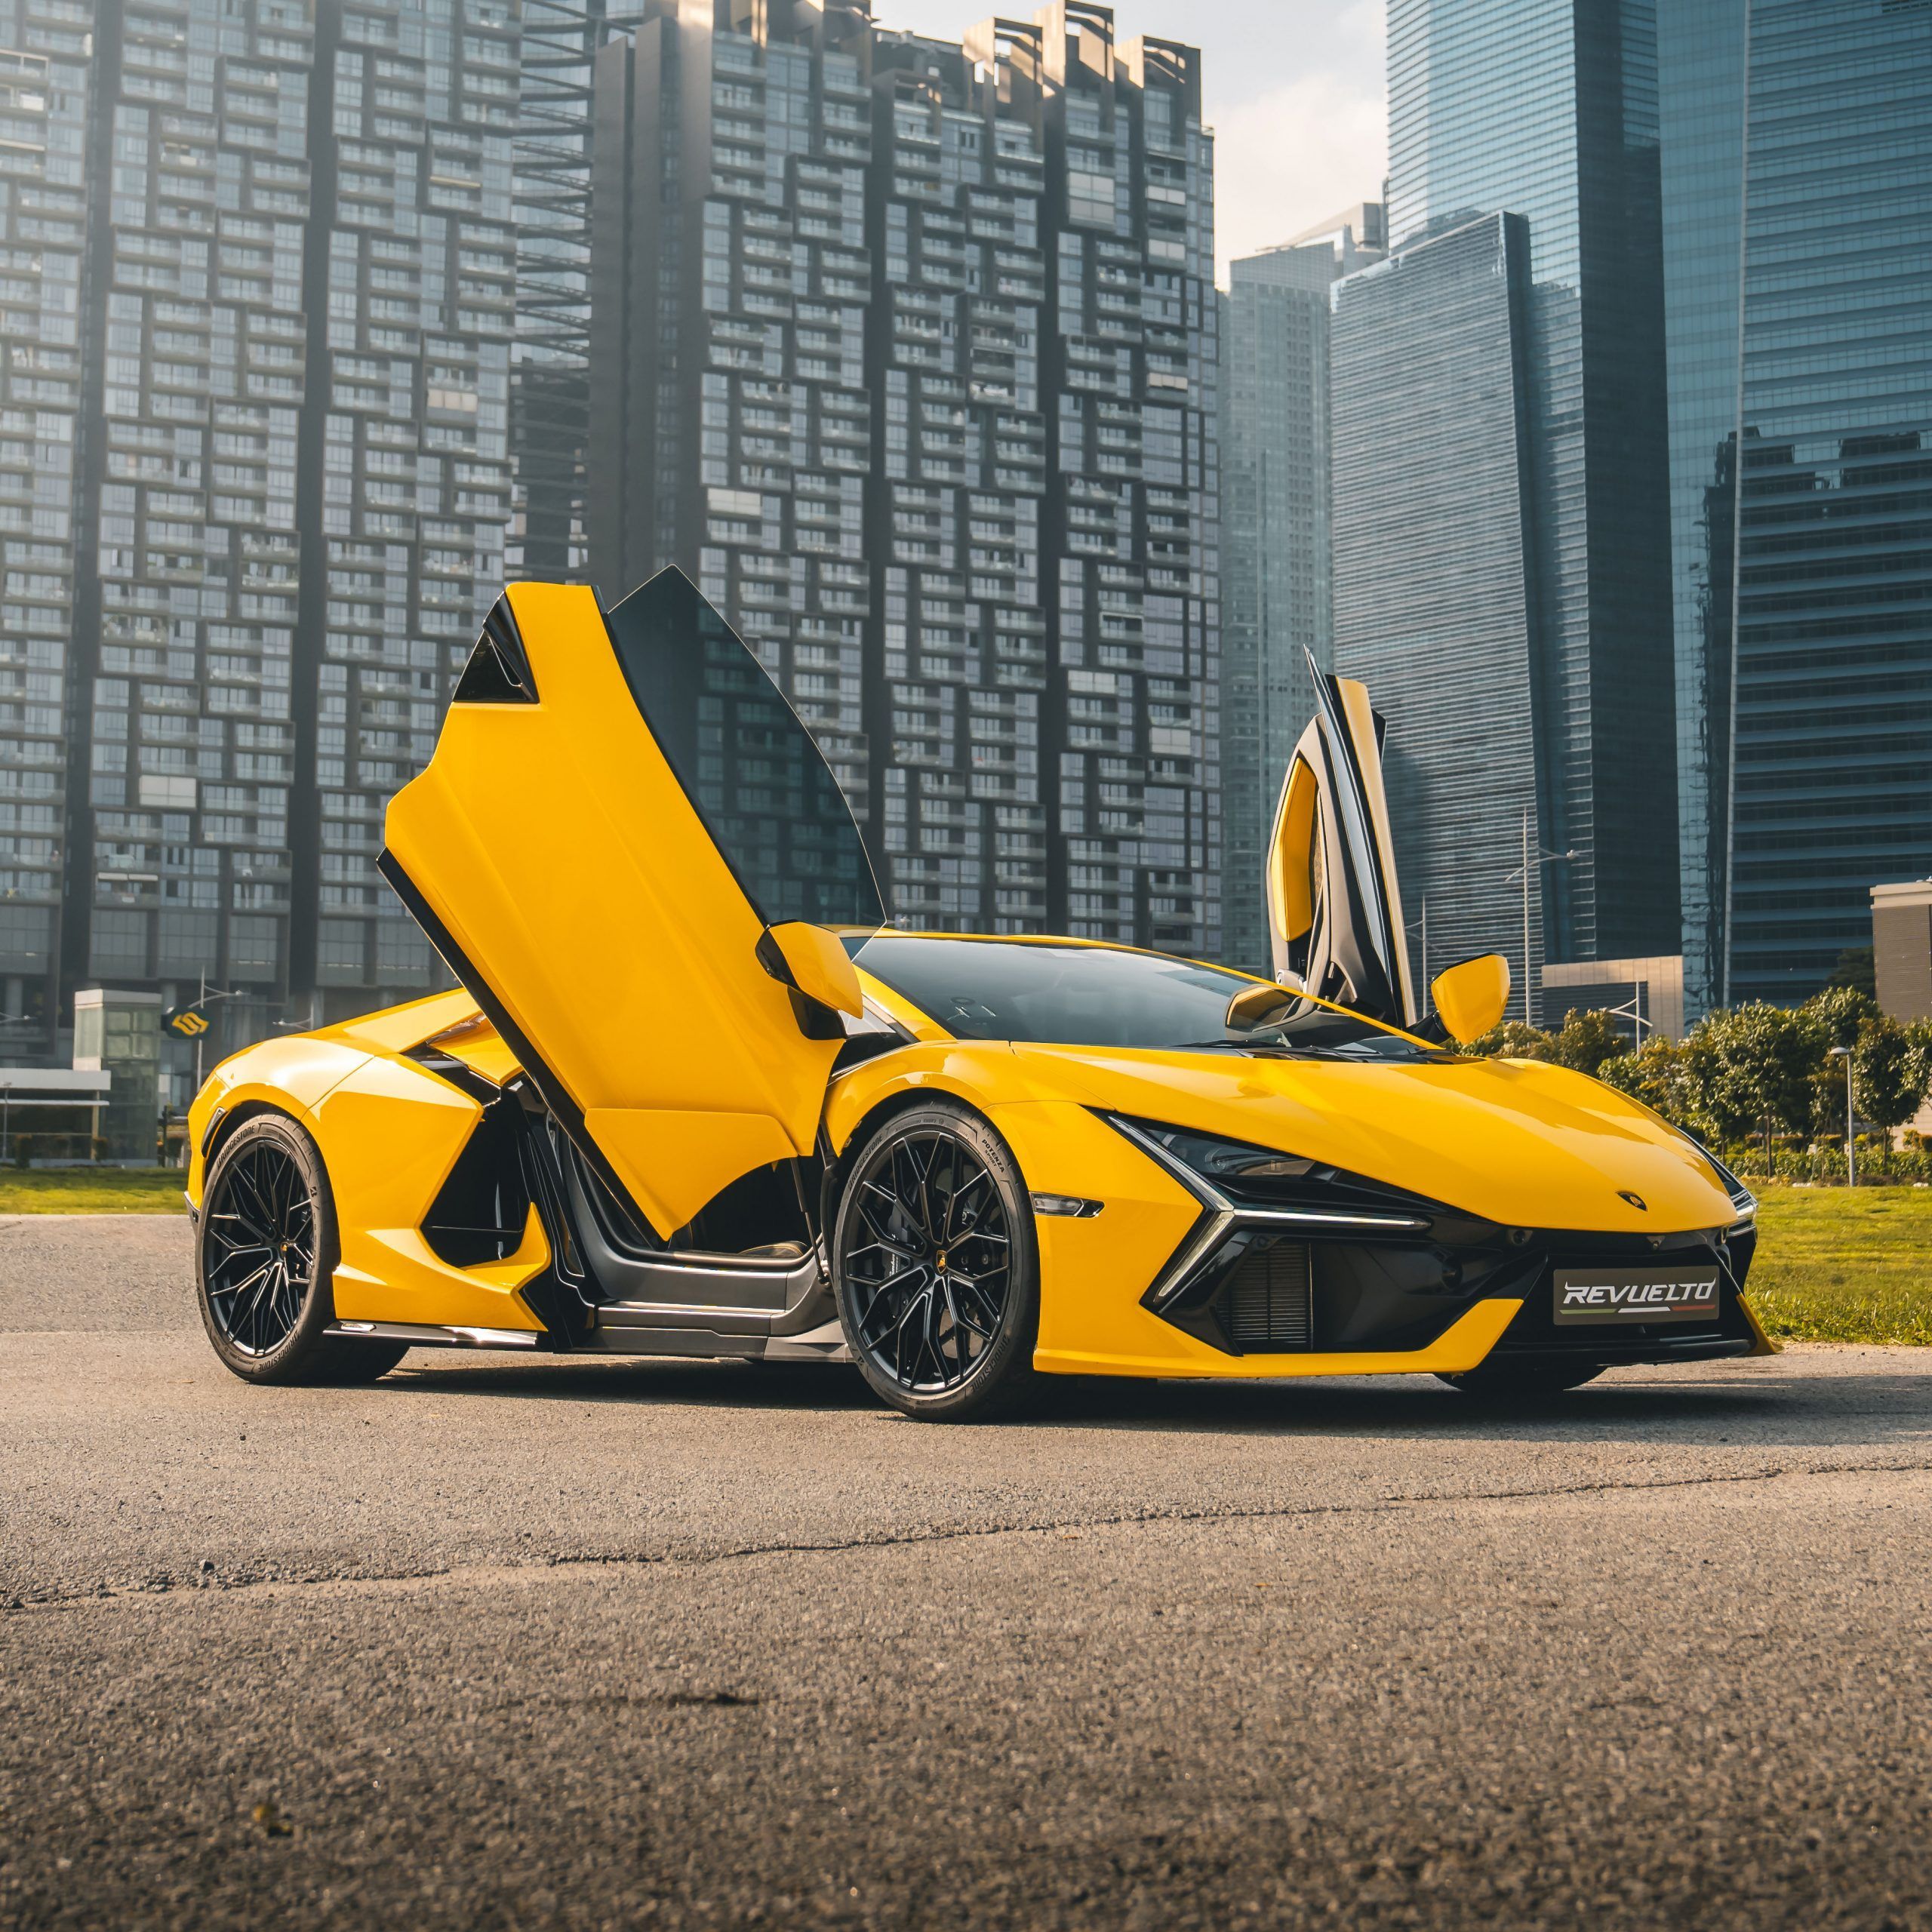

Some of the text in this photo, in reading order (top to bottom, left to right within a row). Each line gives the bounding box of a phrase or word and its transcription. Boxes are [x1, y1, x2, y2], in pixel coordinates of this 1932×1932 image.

[217, 1124, 255, 1171] BRIDGESTONE
[848, 1134, 883, 1192] BRIDGESTONE
[982, 1139, 1004, 1173] POTENZA
[985, 1149, 997, 1167] SPORT
[1562, 1277, 1716, 1304] REVUELTO
